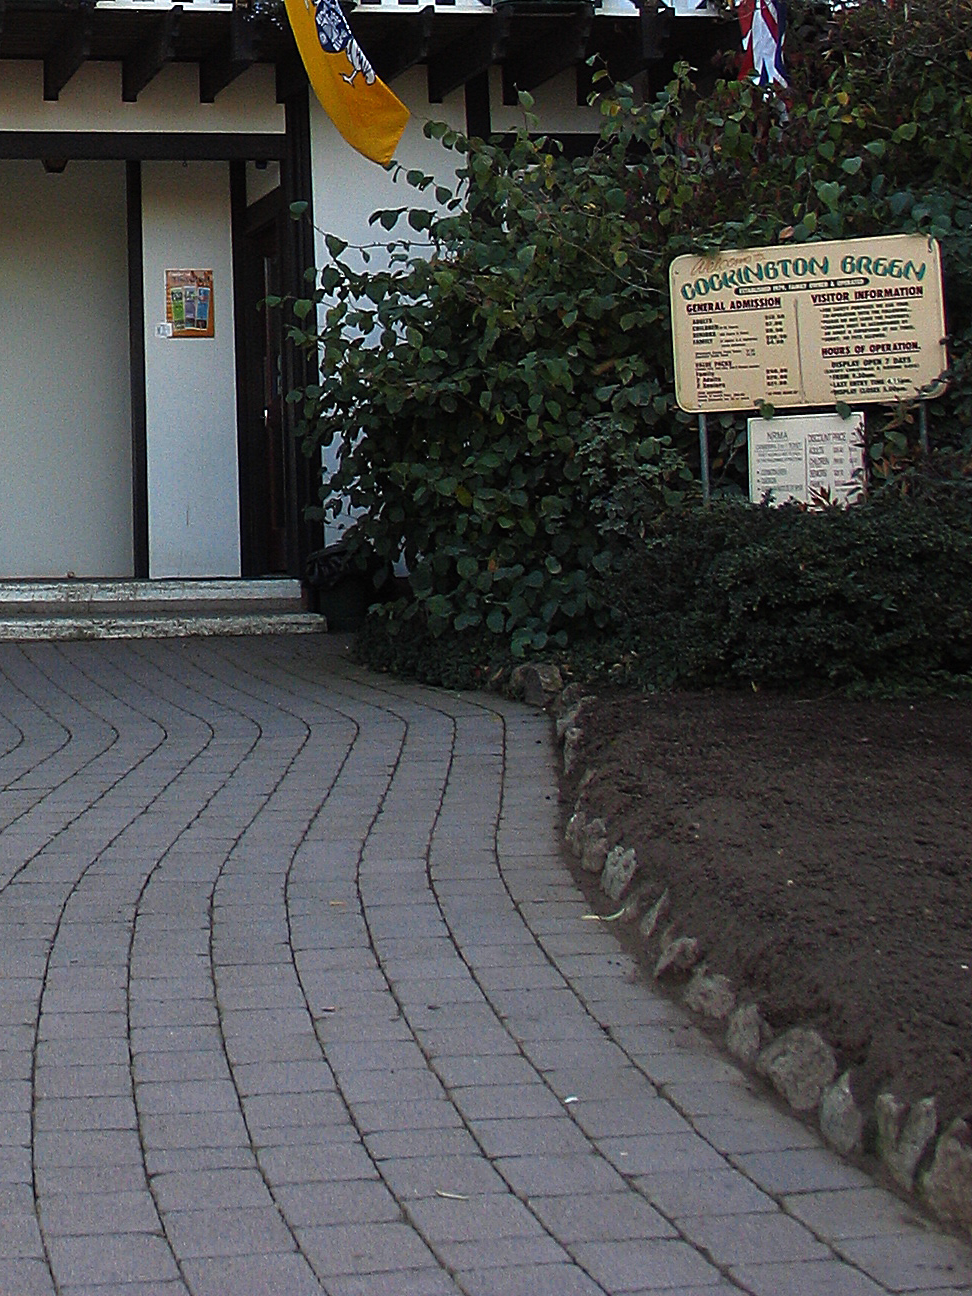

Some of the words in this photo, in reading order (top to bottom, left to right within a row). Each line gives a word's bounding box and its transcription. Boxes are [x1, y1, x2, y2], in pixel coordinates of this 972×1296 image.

[681, 255, 829, 300] COCKINGTON
[841, 255, 926, 281] GREEN
[811, 292, 849, 303] VISITOR
[855, 286, 923, 299] INFORMATION
[687, 302, 725, 312] GENERAL
[730, 297, 781, 309] ADMISSION
[822, 346, 850, 356] HOURS
[855, 345, 865, 353] OF
[869, 342, 921, 353] OPERATION.
[831, 359, 859, 368] DISPLAY
[864, 358, 882, 366] OPEN
